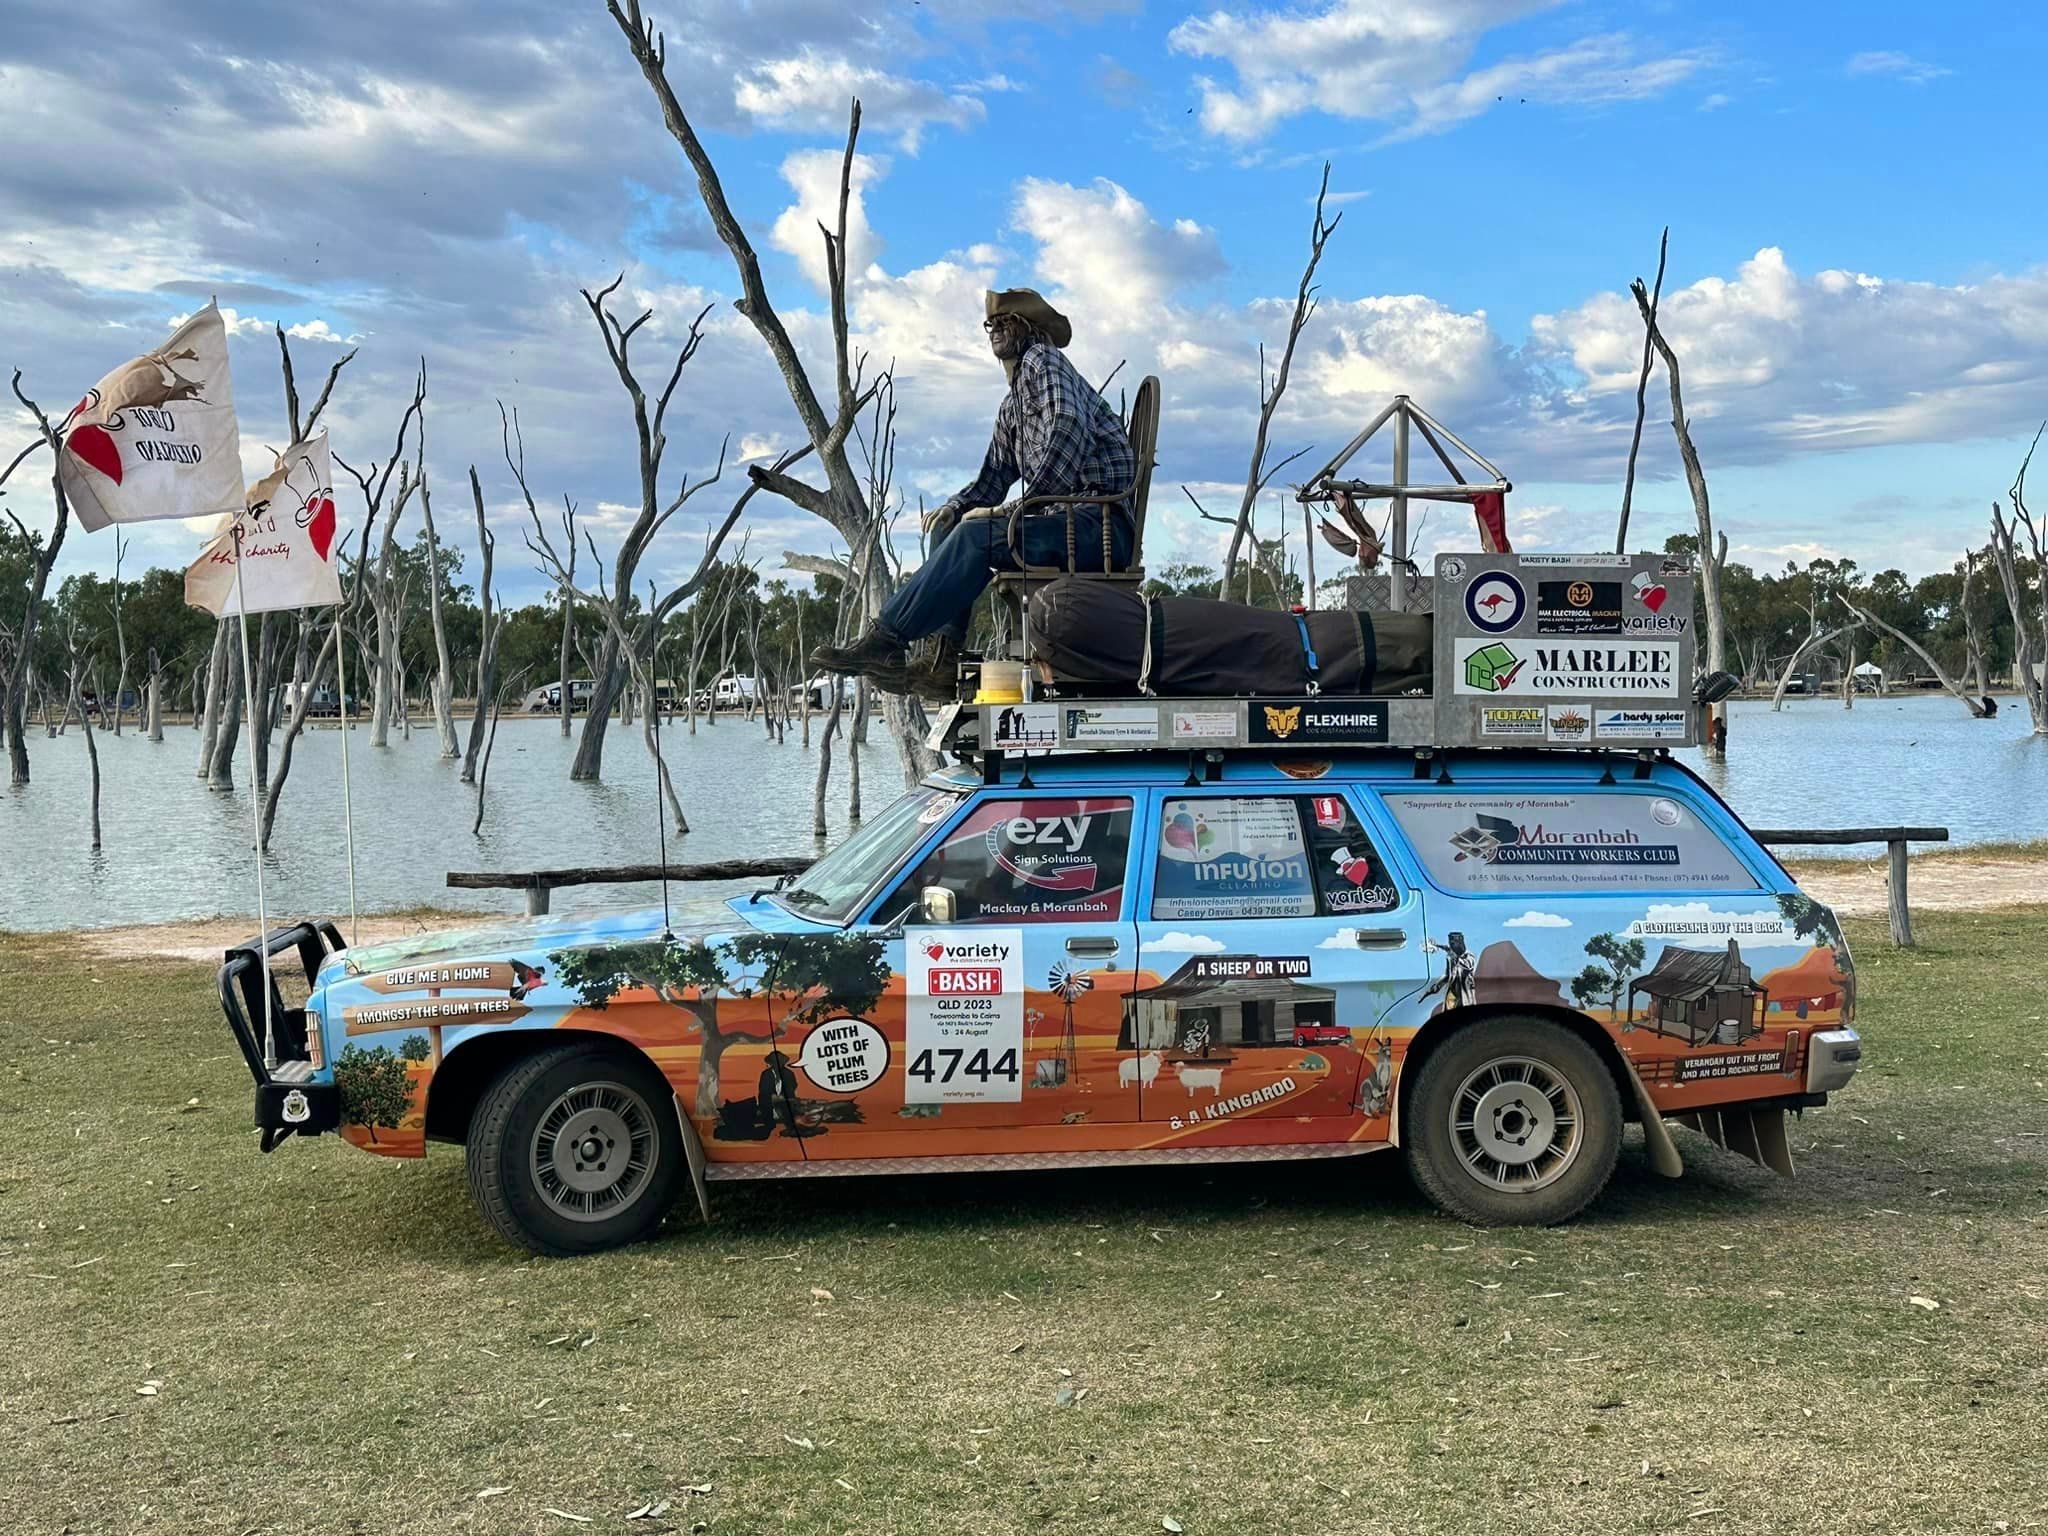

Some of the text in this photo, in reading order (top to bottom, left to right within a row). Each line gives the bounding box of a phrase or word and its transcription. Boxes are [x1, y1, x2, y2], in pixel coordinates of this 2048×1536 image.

[246, 542, 290, 559] charity
[1551, 556, 1571, 564] BASH
[1622, 614, 1688, 633] variety
[1536, 650, 1671, 672] MARLEE
[1532, 676, 1670, 689] CONSTRUCTIONS
[1305, 715, 1378, 726] FLEXIHIRE
[1486, 709, 1541, 721] TOTAL
[1623, 712, 1684, 723] hardy spicer
[1469, 801, 1513, 809] community
[1516, 800, 1525, 809] of
[1006, 816, 1092, 853] ezy
[1515, 824, 1639, 847] Moranbah
[1014, 854, 1093, 865] Sign Solutions
[1500, 849, 1677, 862] COMMUNITY WORKERS CLUB
[1572, 873, 1618, 882] Queensland
[1220, 882, 1281, 890] CLEANING
[1327, 886, 1394, 905] variety
[980, 902, 1108, 915] Mackay & Moranbah
[1633, 920, 1783, 934] A CLOTHESLINE OUT THE BACK
[946, 944, 1009, 961] variety
[1197, 960, 1309, 976] A SHEEP OR TWO
[386, 968, 491, 986] GIVE ME A HOME
[939, 972, 992, 992] BASH
[356, 1000, 510, 1025] AMONGST THE GUM TREES
[938, 1000, 992, 1010] QLD 2023
[822, 1025, 859, 1042] WITH
[966, 1029, 989, 1037] August
[816, 1039, 870, 1059] LOTS OF
[827, 1055, 865, 1073] PLUM
[908, 1048, 1019, 1084] 4744
[1685, 1053, 1780, 1068] VERANDAH OUT THE FRONT
[828, 1069, 869, 1087] TREES
[1682, 1063, 1780, 1079] AND AN OLD ROCKING CHAIR
[1170, 1076, 1297, 1130] & A KANGAROO
